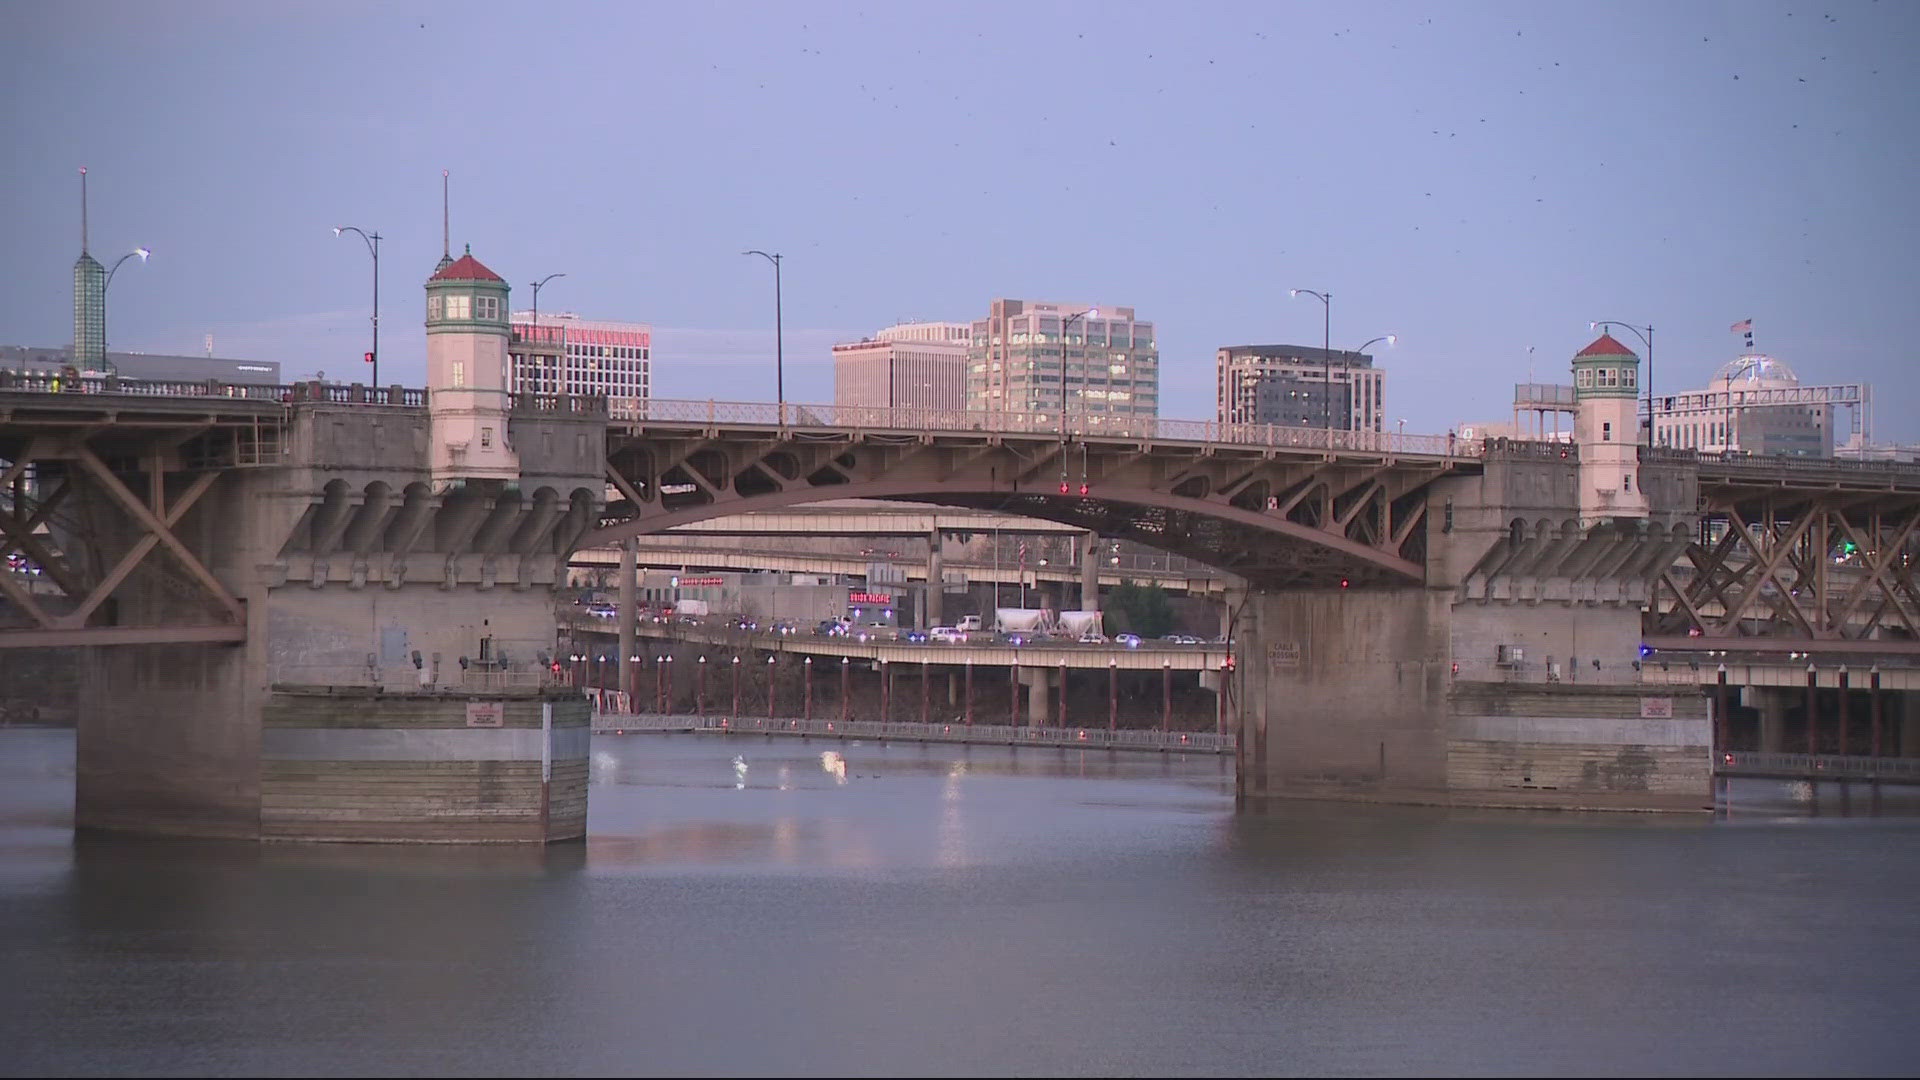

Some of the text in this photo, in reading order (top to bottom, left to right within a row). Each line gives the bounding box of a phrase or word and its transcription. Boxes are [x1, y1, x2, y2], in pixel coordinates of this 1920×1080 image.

[850, 592, 890, 603] UNION PACIFIC
[1274, 642, 1293, 651] CABLE
[1268, 650, 1299, 658] CROSSING
